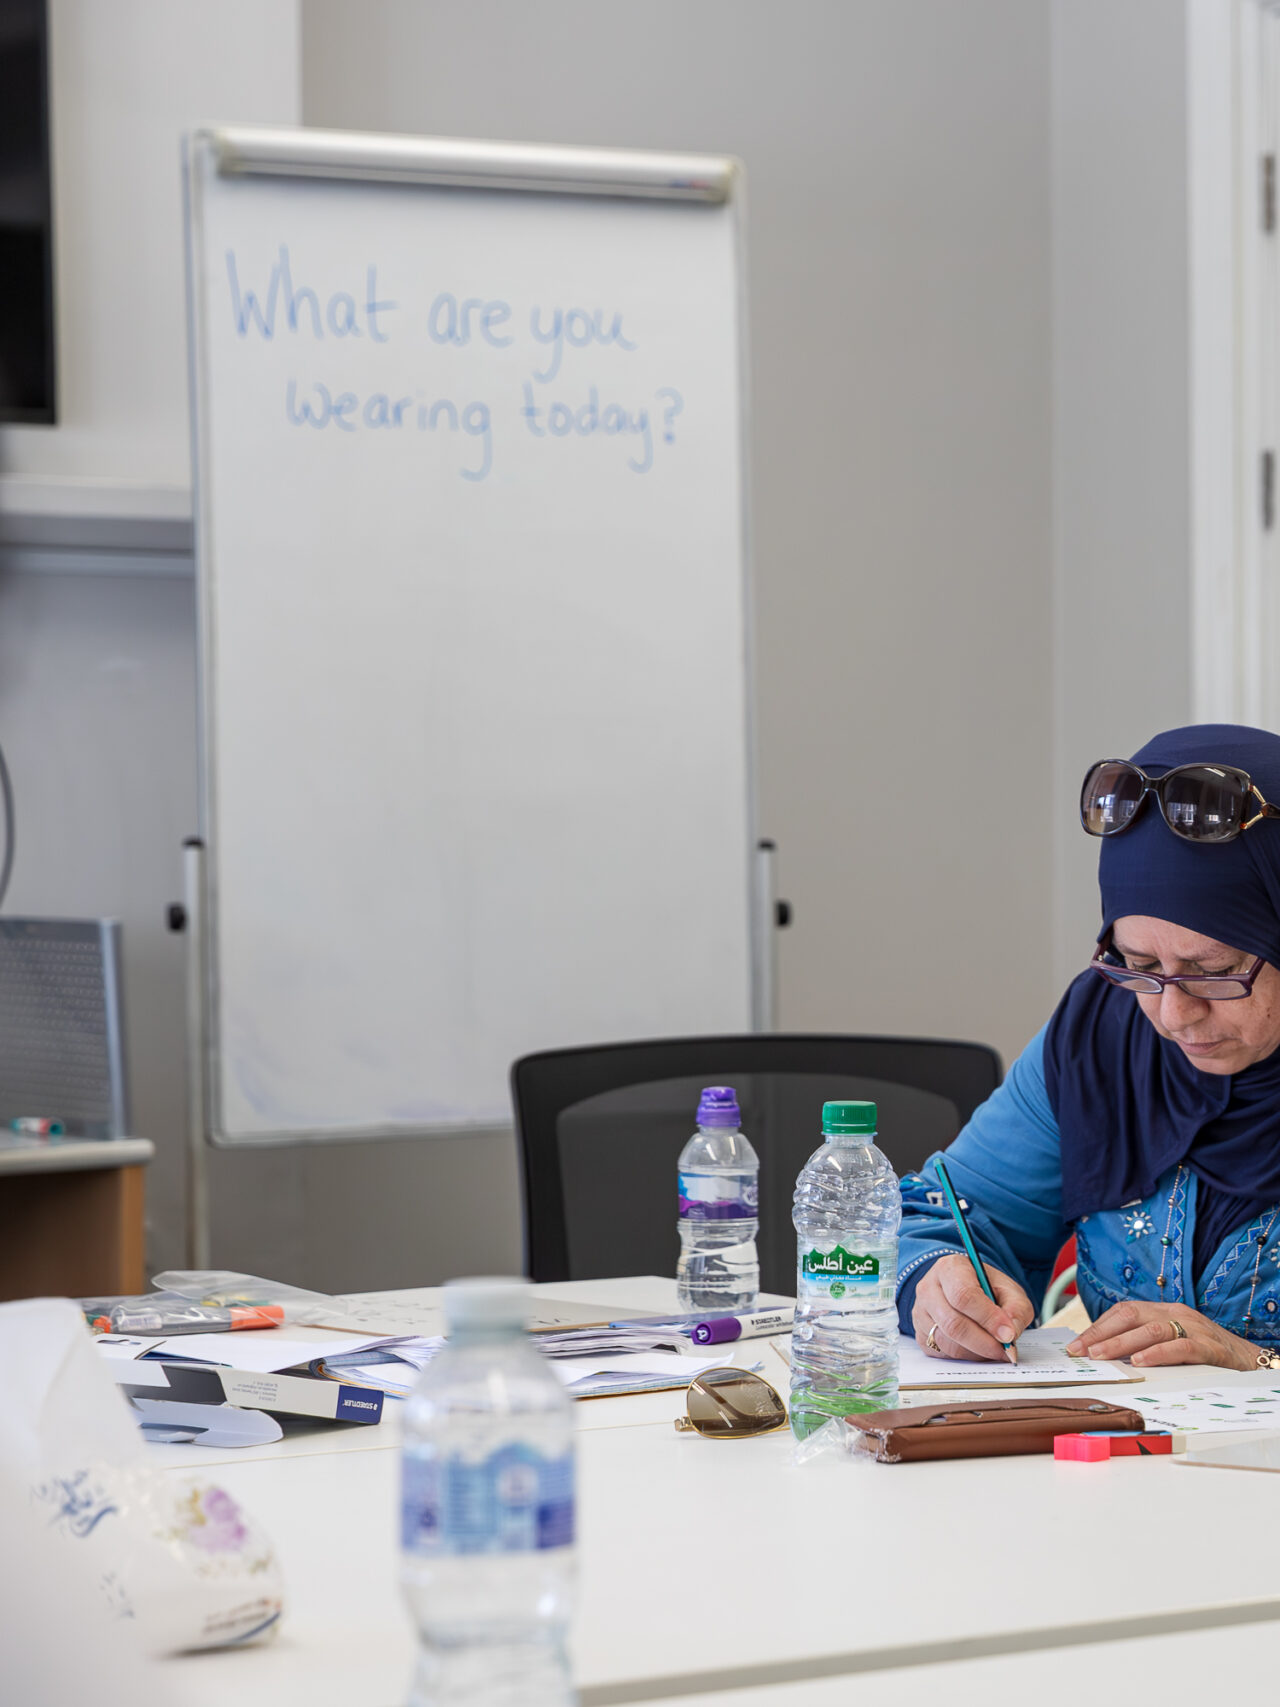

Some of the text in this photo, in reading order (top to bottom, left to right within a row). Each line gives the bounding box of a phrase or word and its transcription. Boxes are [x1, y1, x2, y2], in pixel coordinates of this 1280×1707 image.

[225, 243, 638, 384] What are you
[286, 379, 685, 482] wearing today?
[808, 1253, 874, 1274] عين أطلس
[343, 1399, 374, 1410] STAEDTLER
